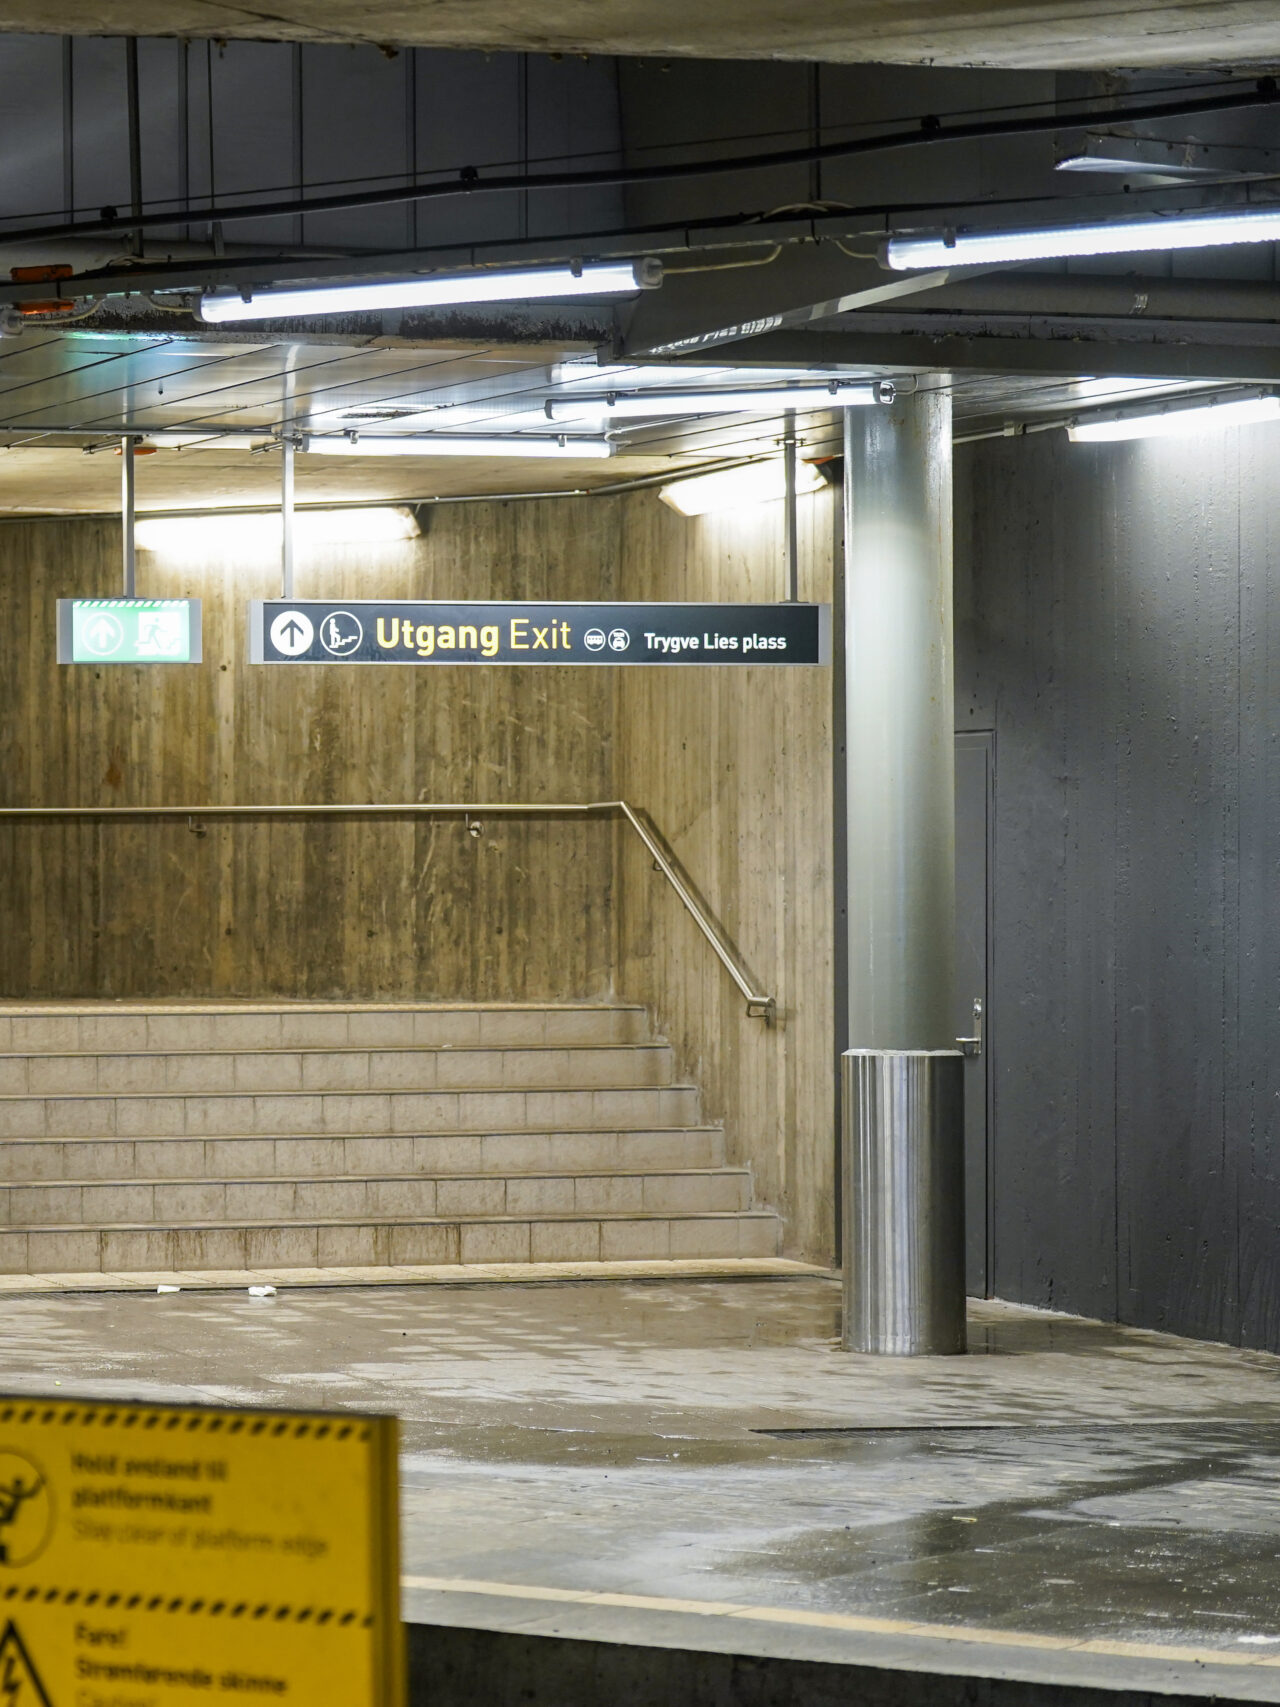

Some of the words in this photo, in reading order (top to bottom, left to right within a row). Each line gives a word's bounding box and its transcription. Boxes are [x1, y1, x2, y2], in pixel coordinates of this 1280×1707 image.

[376, 617, 499, 657] Utgang
[510, 618, 572, 649] Exit
[644, 632, 699, 653] Trygve
[704, 633, 738, 650] Lies
[742, 633, 787, 654] plass
